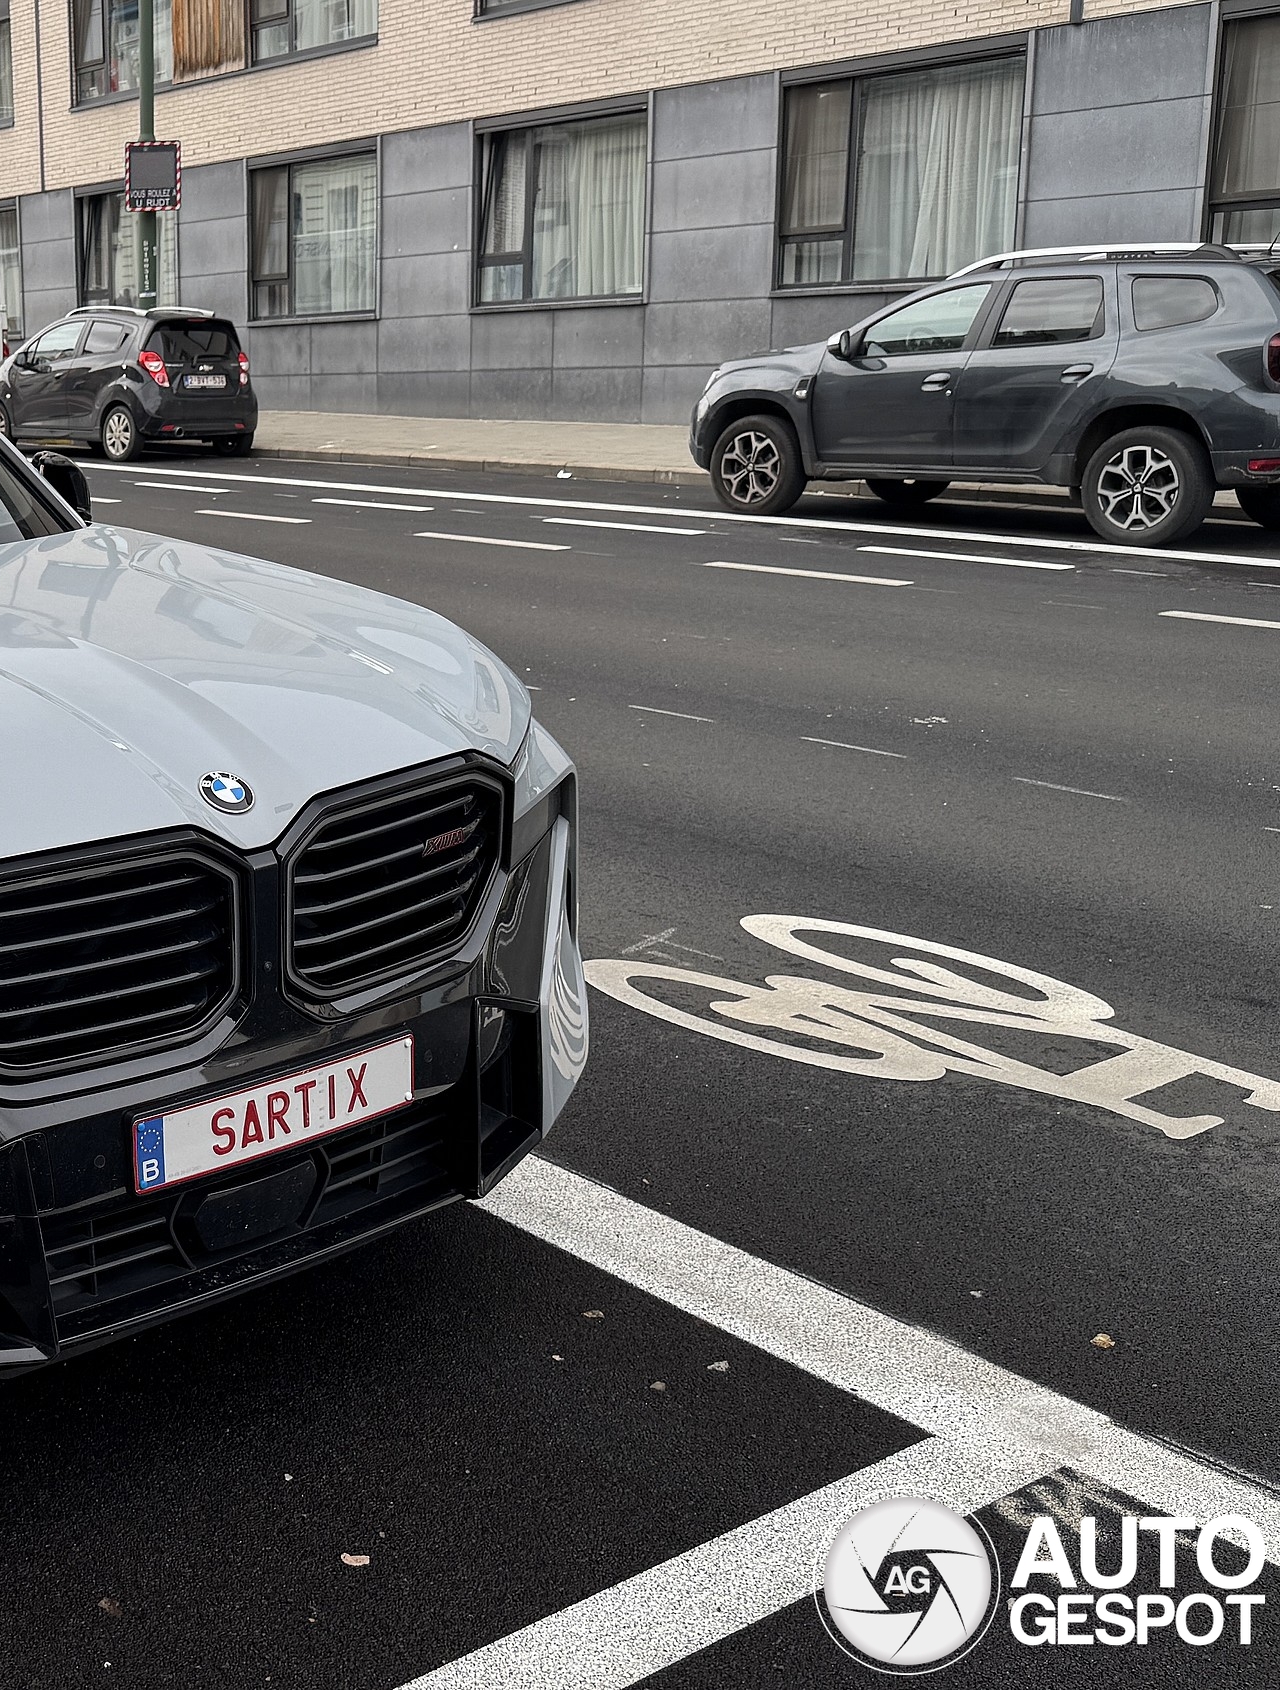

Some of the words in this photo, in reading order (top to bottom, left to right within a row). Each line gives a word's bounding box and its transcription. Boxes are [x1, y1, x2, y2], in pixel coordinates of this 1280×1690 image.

[147, 188, 171, 197] ROULEZ
[135, 199, 143, 207] U
[142, 1158, 160, 1182] B
